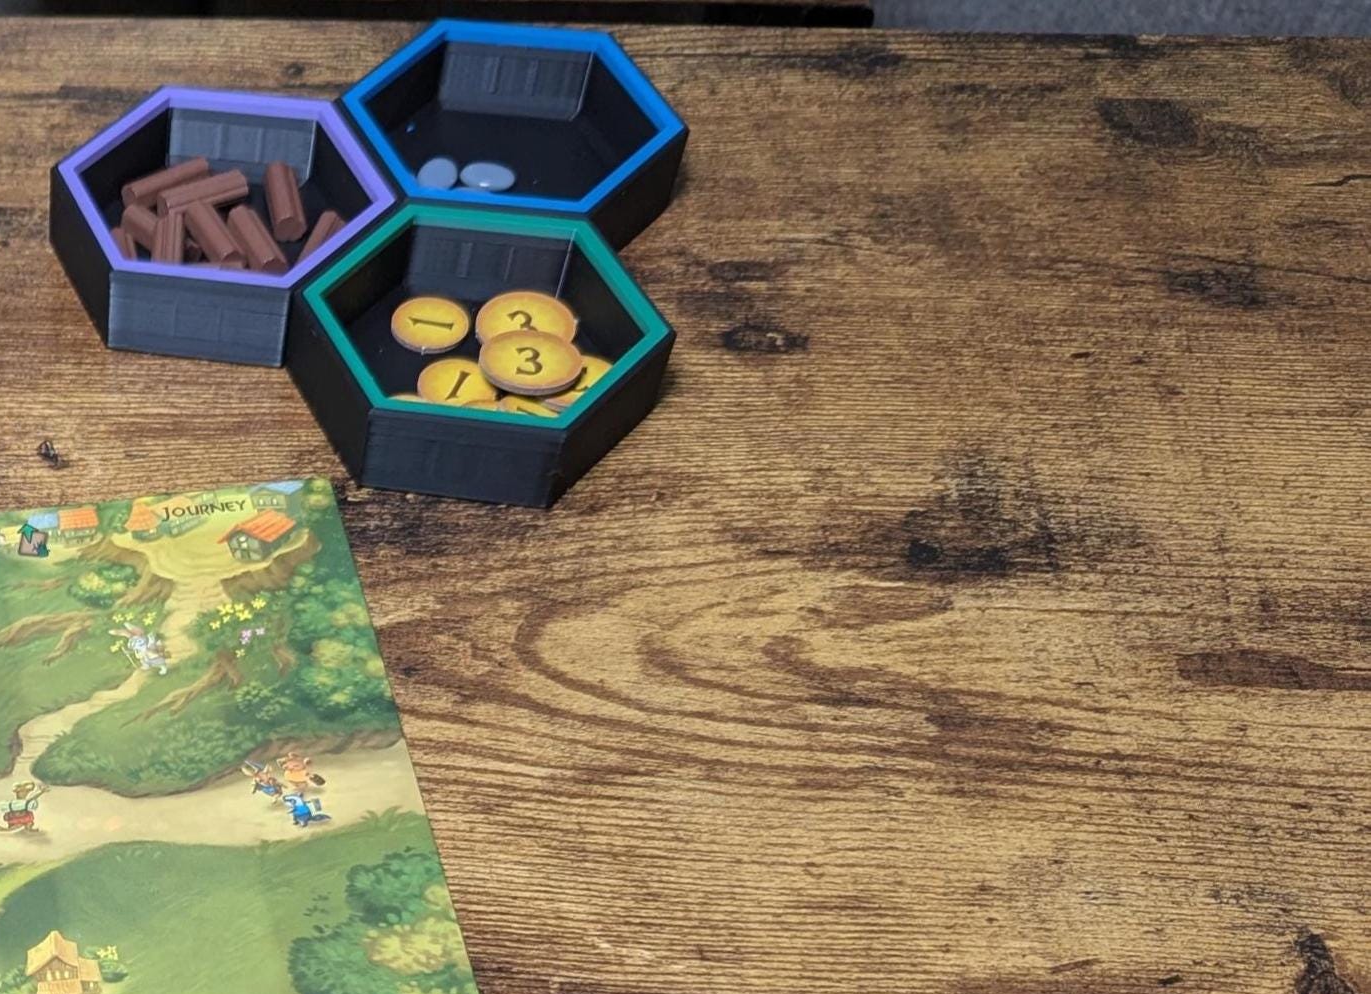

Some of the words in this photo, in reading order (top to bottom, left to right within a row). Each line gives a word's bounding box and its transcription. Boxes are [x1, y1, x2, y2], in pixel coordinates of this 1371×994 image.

[407, 316, 454, 331] 1
[515, 346, 544, 376] 3
[445, 370, 471, 400] 1
[161, 499, 247, 523] JOURNEY
